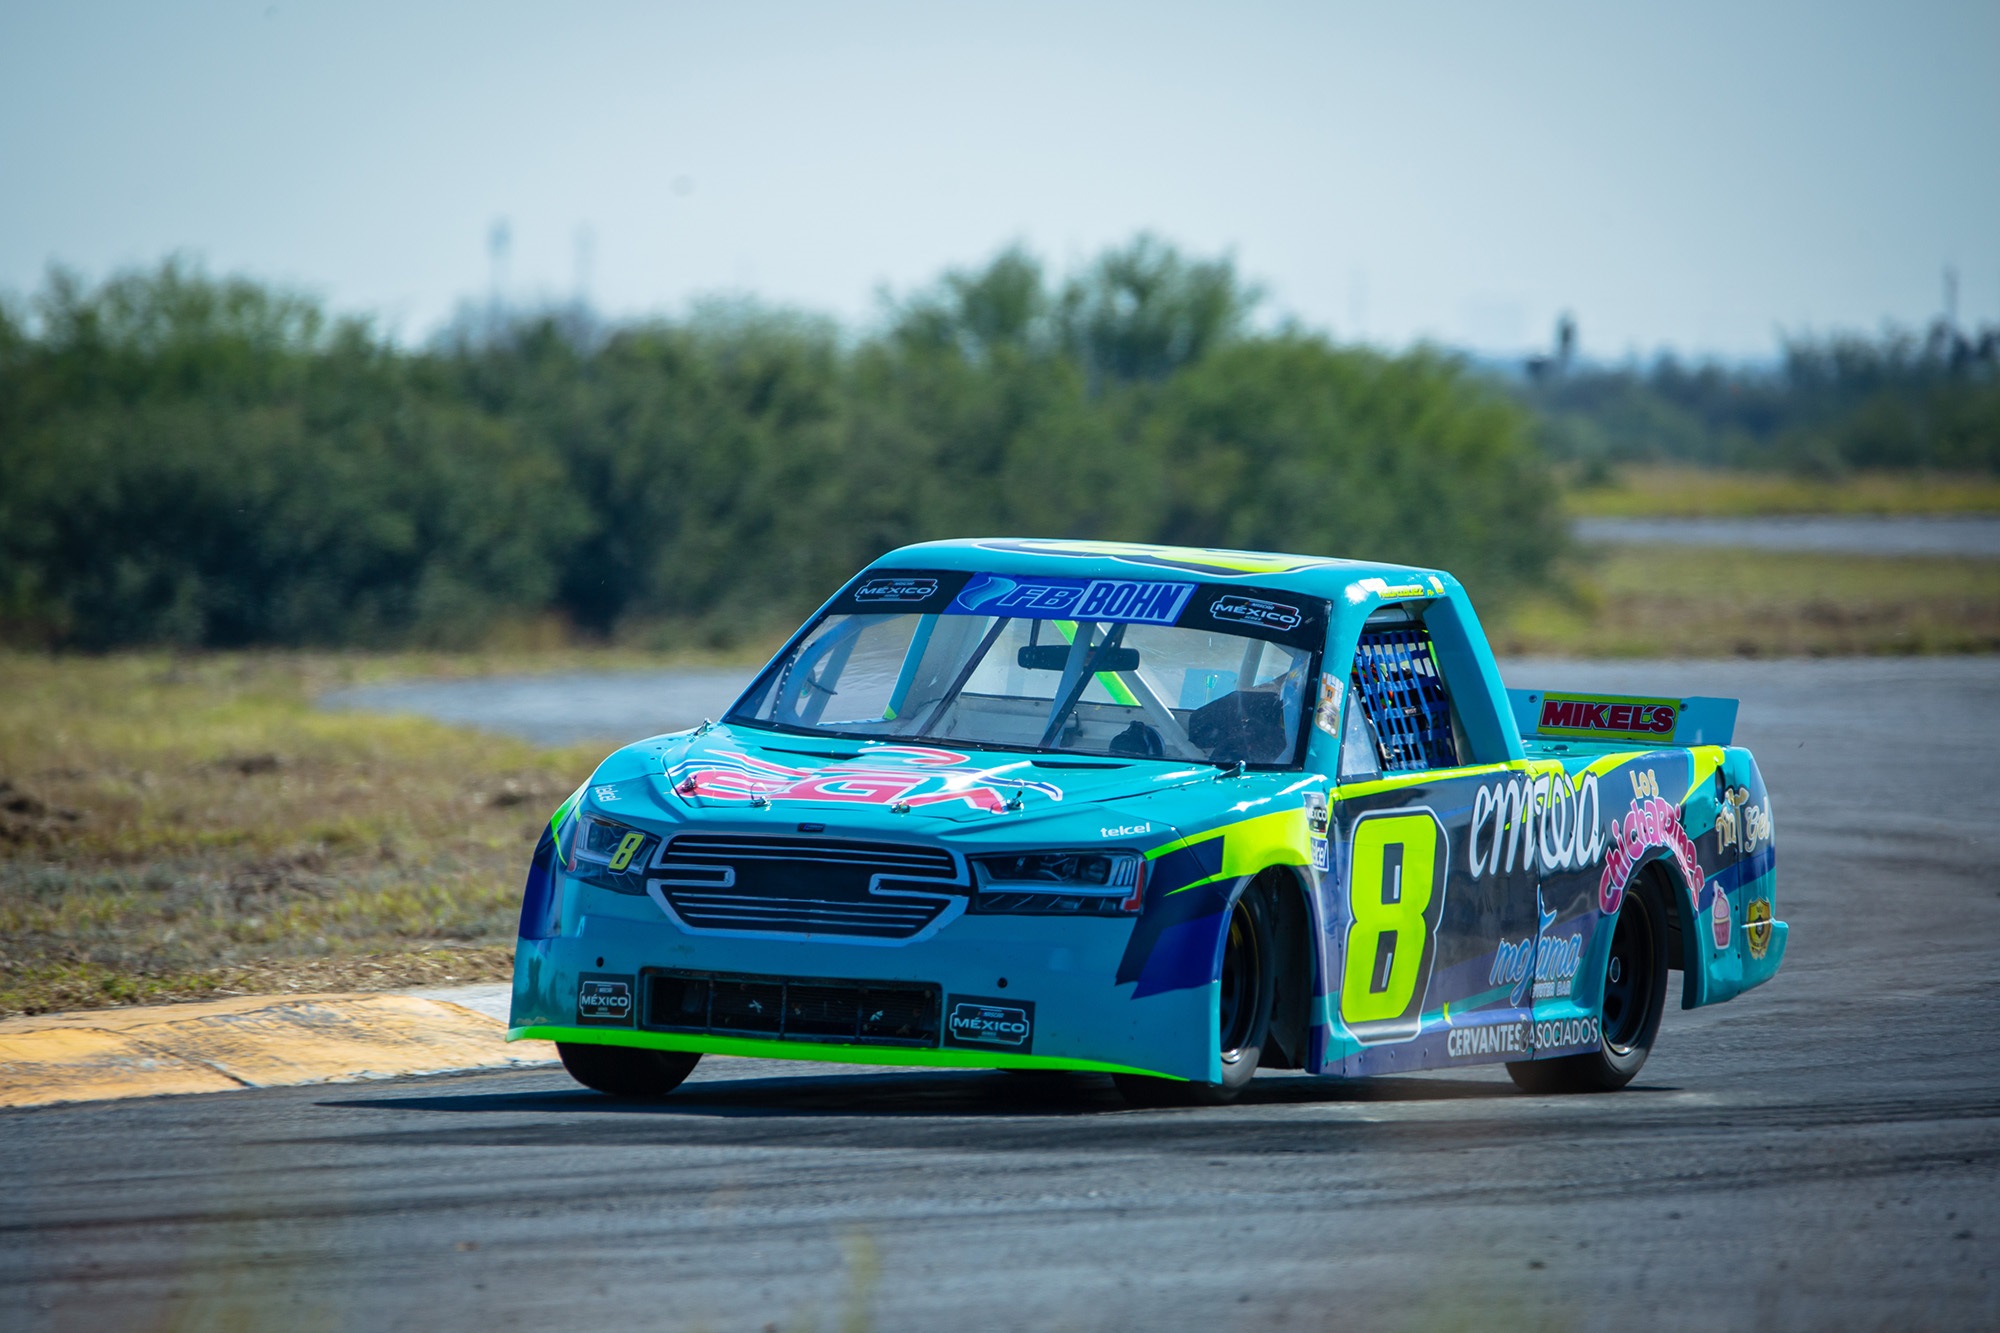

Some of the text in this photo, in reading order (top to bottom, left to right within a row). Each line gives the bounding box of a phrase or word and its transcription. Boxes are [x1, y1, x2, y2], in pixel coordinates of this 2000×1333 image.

[860, 586, 932, 594] MÉXICO
[997, 584, 1085, 610] FB
[1076, 582, 1176, 620] BOHN
[1214, 603, 1296, 624] MÉXICO
[1540, 701, 1676, 733] MIKEL'S
[1100, 822, 1151, 838] telcel
[609, 833, 644, 871] 8
[1340, 814, 1440, 1027] 8
[581, 994, 628, 1007] MÉXICO
[953, 1017, 1025, 1033] MÉXICO
[1447, 1023, 1522, 1057] CERVANTES
[1529, 1018, 1598, 1049] ASOCIADOS
